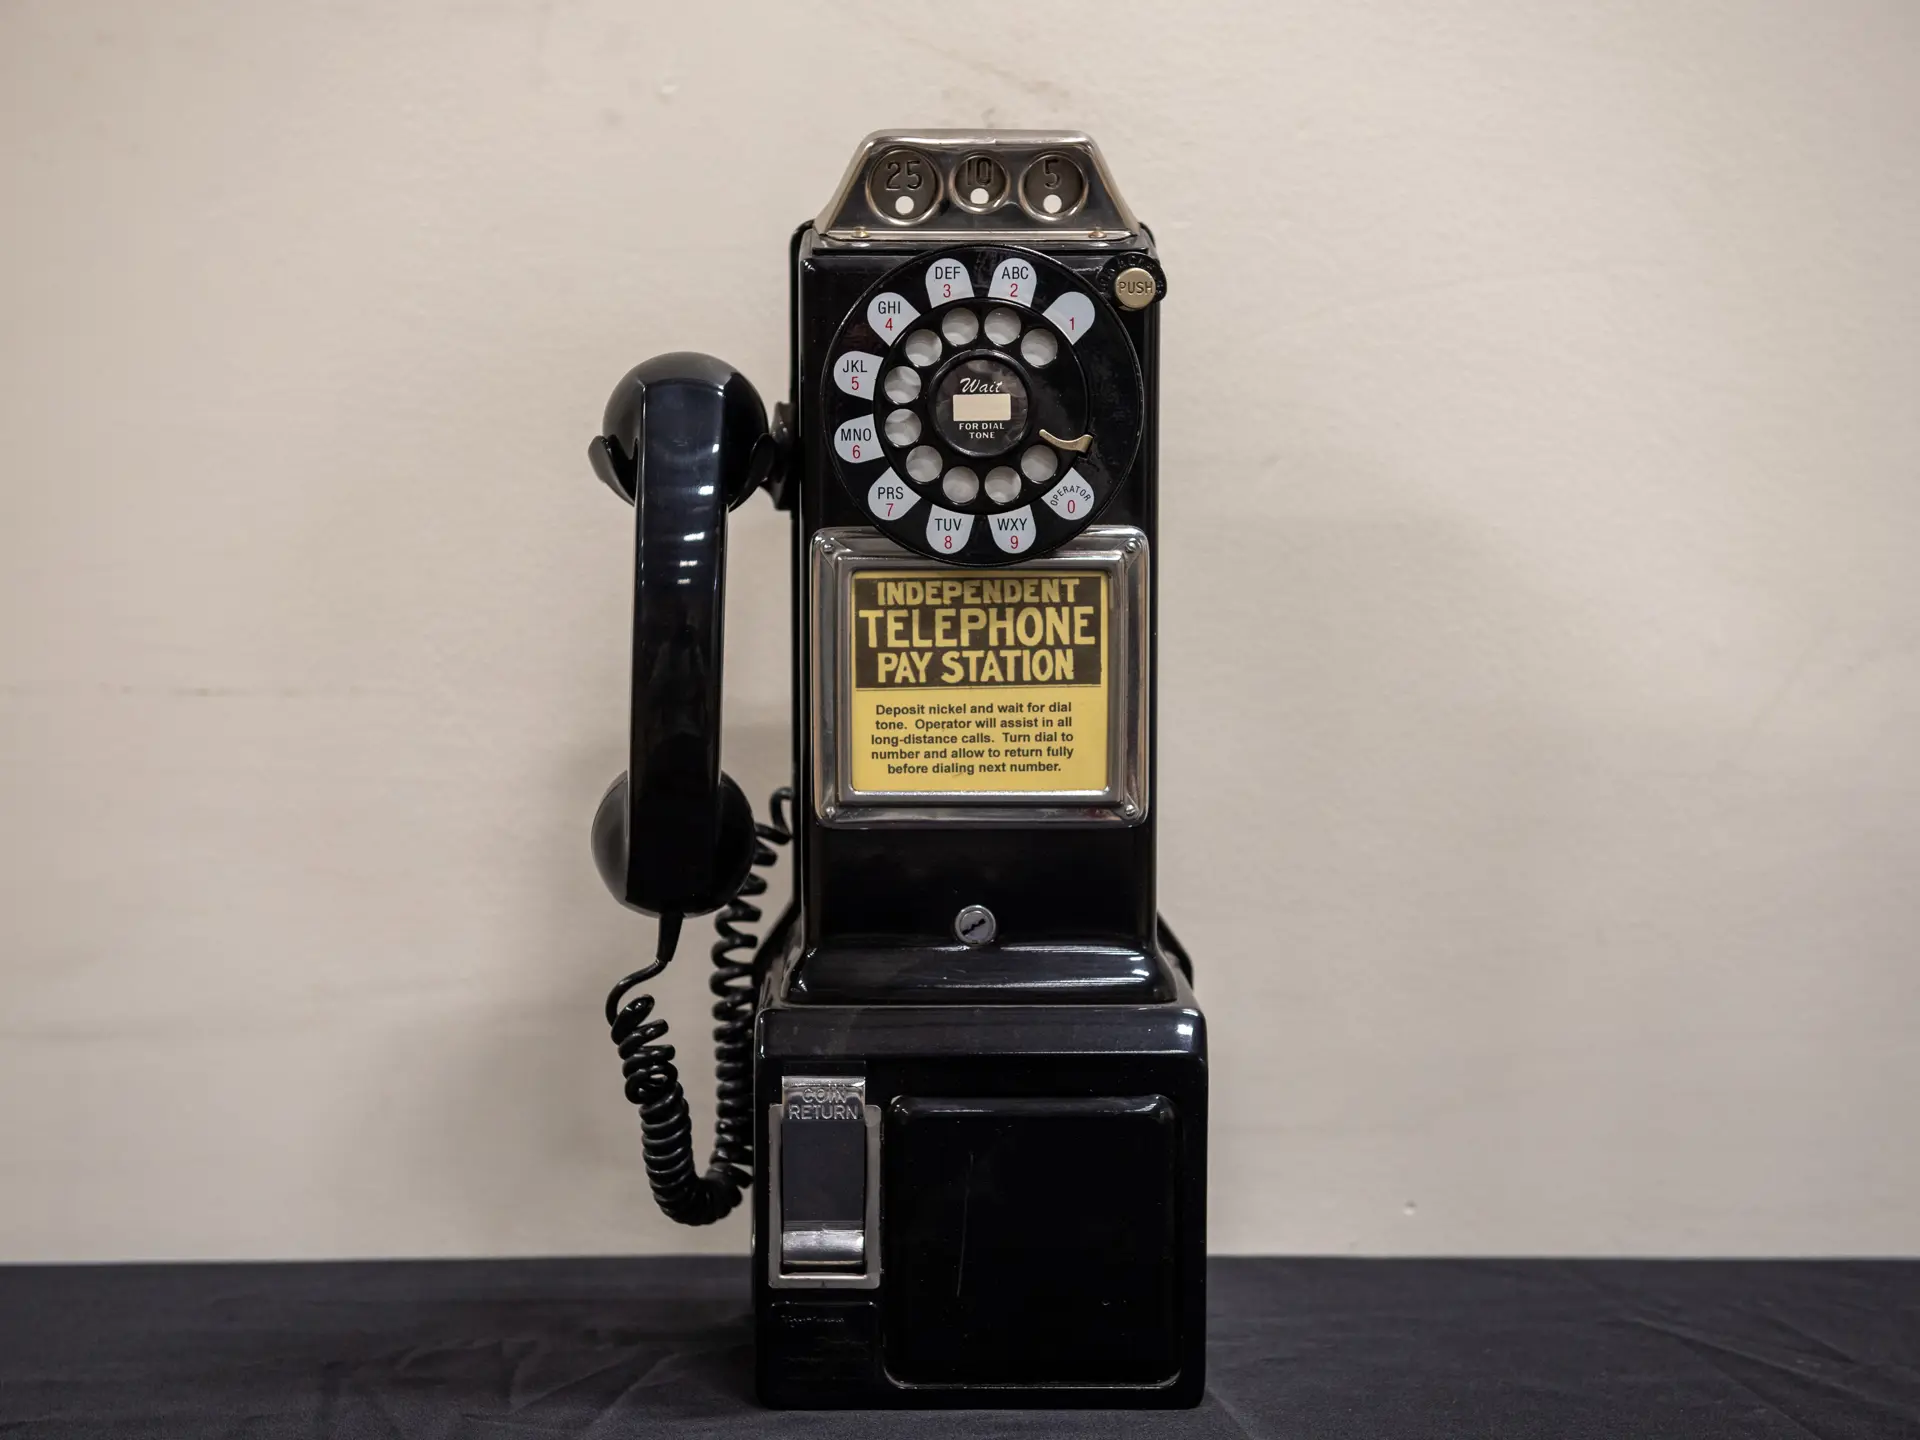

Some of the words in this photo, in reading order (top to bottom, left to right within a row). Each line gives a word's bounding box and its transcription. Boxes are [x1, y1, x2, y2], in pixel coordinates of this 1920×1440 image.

[886, 160, 923, 191] 25
[966, 157, 993, 186] 10
[1043, 158, 1061, 189] 5
[934, 266, 961, 280] DEF
[1001, 265, 1029, 280] ABC
[942, 283, 952, 299] 3
[1009, 282, 1019, 298] 2
[1118, 281, 1153, 294] PUSH
[877, 300, 901, 315] GHI
[884, 317, 894, 331] 4
[1069, 316, 1075, 331] 1
[842, 359, 868, 373] JKL
[851, 375, 860, 391] 5
[959, 377, 1003, 393] Wait
[840, 427, 872, 442] MNO
[958, 422, 979, 431] FOR
[981, 422, 1005, 430] DIAL
[969, 431, 995, 439] TONE
[852, 444, 861, 460] 6
[877, 486, 904, 500] PRS
[1050, 485, 1091, 506] OPERATOR
[885, 502, 894, 518] 7
[1067, 499, 1076, 514] 0
[934, 518, 962, 532] TUV
[996, 517, 1028, 531] WXY
[943, 535, 953, 550] 8
[1010, 535, 1019, 550] 9
[877, 579, 1079, 605] INDEPENDENT
[859, 606, 1095, 648] TELEPHONE
[878, 652, 933, 683] PAY
[941, 649, 1074, 683] STATION
[875, 703, 926, 718] Deposit
[928, 703, 967, 715] nickel
[969, 702, 994, 714] and
[996, 702, 1024, 714] wait
[1026, 701, 1046, 713] for
[1048, 701, 1072, 713] dial
[875, 719, 908, 730] tone.
[914, 718, 973, 733] Operator
[974, 717, 997, 729] will
[999, 716, 1039, 729] assist
[1041, 716, 1054, 728] in
[1057, 716, 1073, 727] all
[871, 733, 958, 748] long-distance
[961, 732, 995, 744] calls.
[1001, 731, 1031, 743] Turn
[1034, 731, 1058, 743] dial
[1060, 731, 1074, 742] to
[871, 748, 921, 760] number
[923, 747, 948, 759] and
[950, 747, 986, 759] allow
[987, 747, 1001, 758] to
[1004, 747, 1043, 758] return
[1046, 745, 1074, 760] fully
[887, 763, 929, 775] before
[931, 762, 975, 776] dialing
[978, 761, 1007, 773] next
[1009, 760, 1062, 773] number.
[802, 1084, 847, 1103] COIN
[788, 1104, 859, 1120] RETURN
